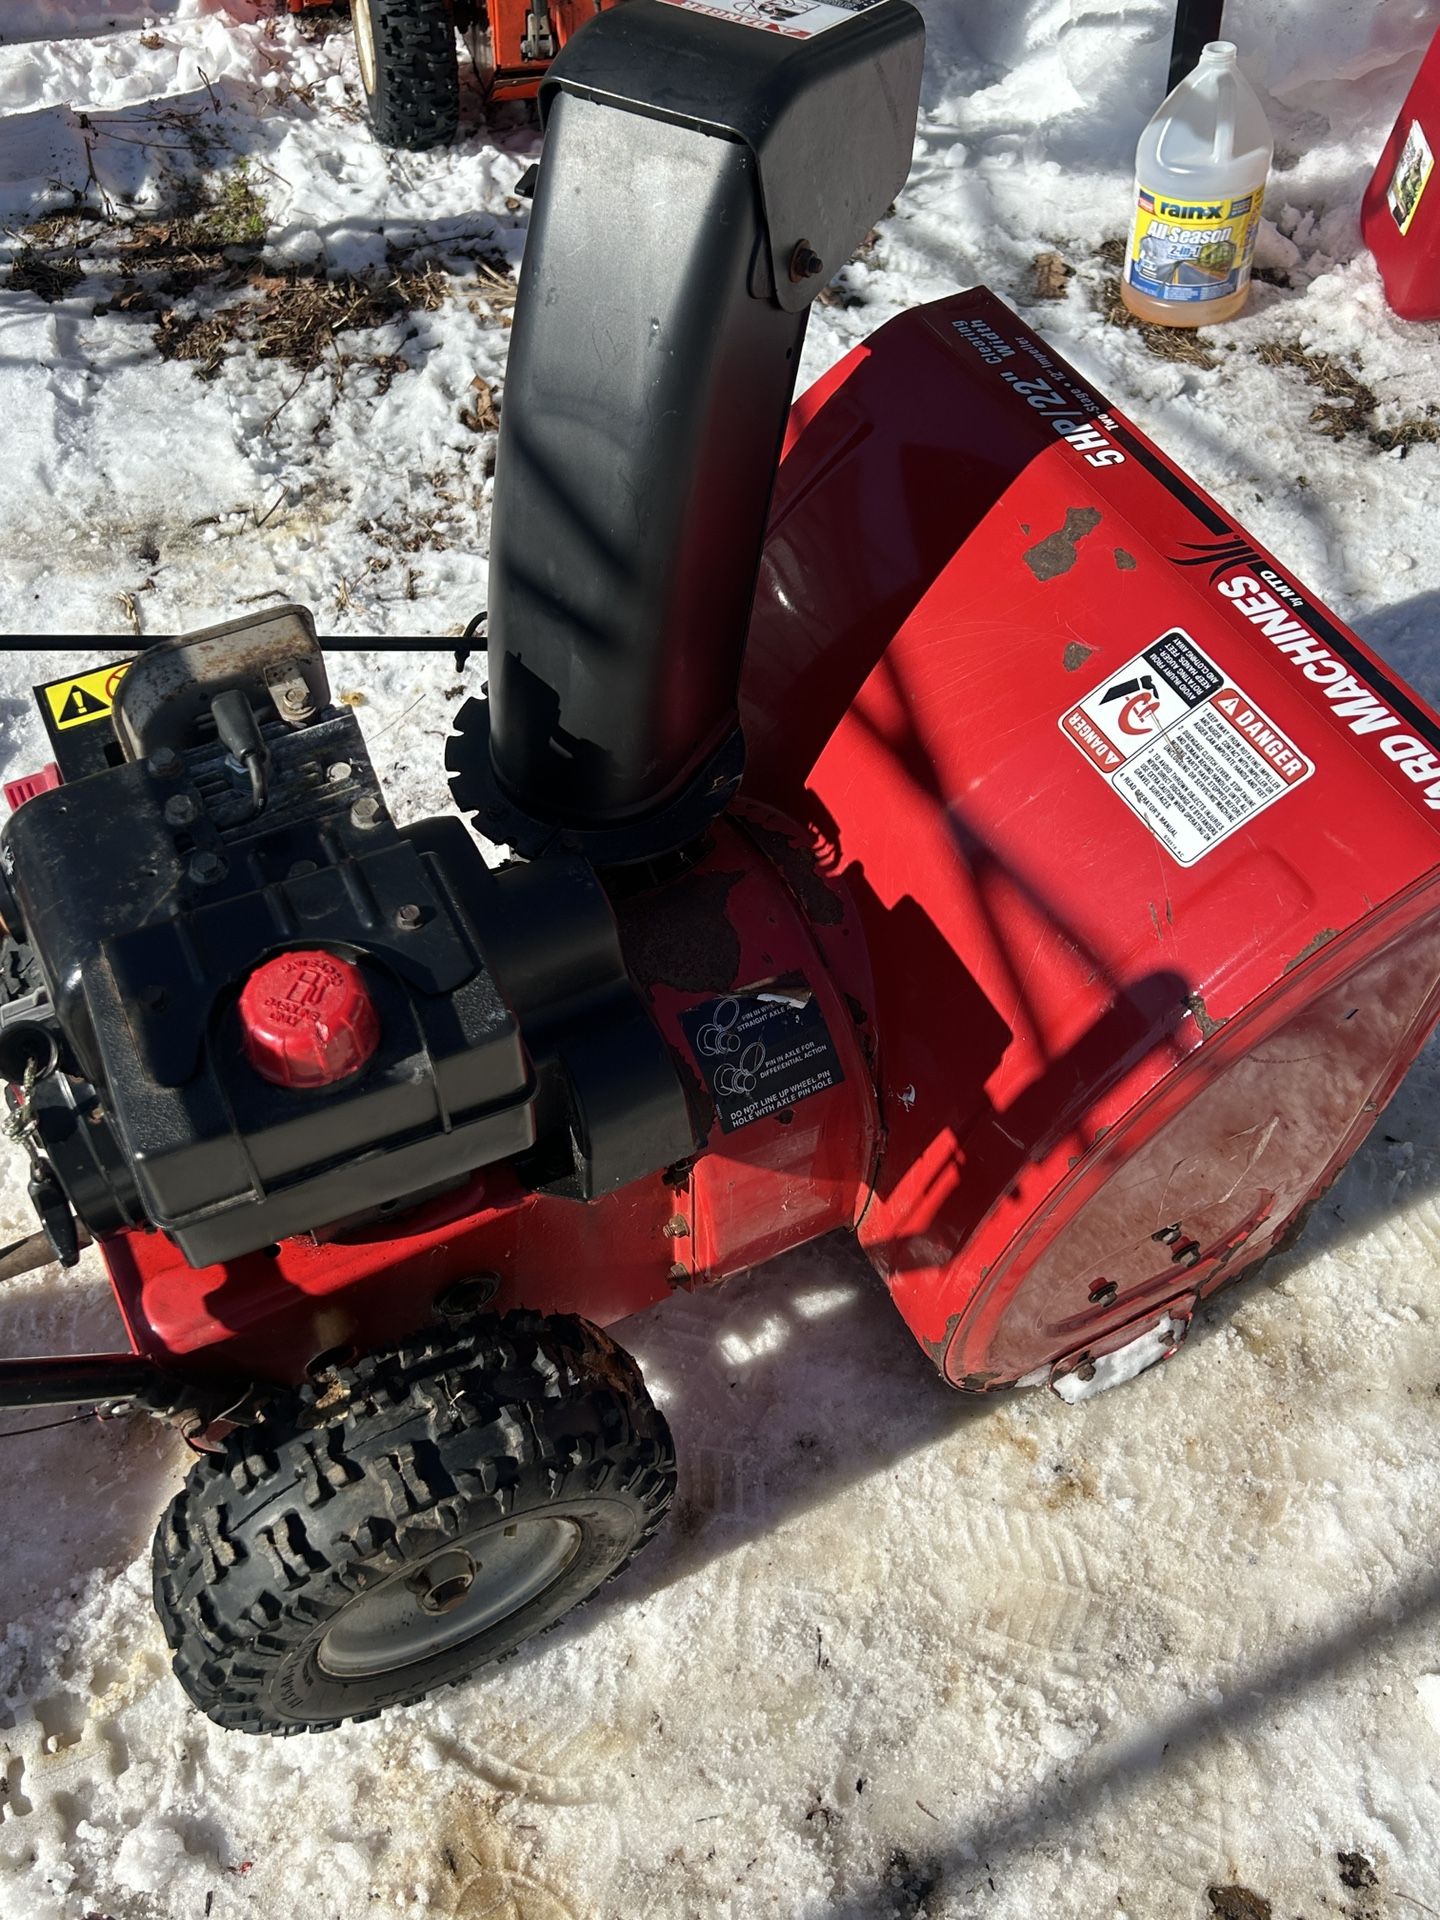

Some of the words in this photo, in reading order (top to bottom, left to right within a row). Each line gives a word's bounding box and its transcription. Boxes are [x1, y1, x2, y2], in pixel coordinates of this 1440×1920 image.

[680, 1, 771, 29] DANGER
[1169, 245, 1202, 257] 2-in-1
[952, 320, 1003, 365] Clearing
[970, 319, 1016, 358] Width
[1014, 336, 1054, 369] Impeller
[1070, 388, 1120, 431] Two-Stage
[1260, 569, 1296, 598] MTD
[1289, 594, 1304, 607] by
[1148, 652, 1166, 669] FROM
[1158, 649, 1180, 670] AUGER
[1163, 641, 1181, 658] FEET
[1184, 649, 1210, 675] CLOTHING
[1217, 575, 1401, 736] MACHINES
[1161, 666, 1182, 686] INJURY
[1174, 666, 1204, 696] ROTATING
[1177, 682, 1197, 702] AVOID
[1193, 672, 1212, 690] KEEP
[1205, 670, 1219, 685] AND
[1064, 710, 1110, 757] DANGER
[1235, 710, 1303, 777] DANGER
[1181, 729, 1204, 752] DISENGAGE
[1200, 749, 1218, 768] CLUTCH
[1228, 780, 1243, 794] STOP
[1191, 720, 1209, 737] AUGER
[1204, 733, 1217, 746] CAN
[1212, 742, 1236, 766] AMPUTATE
[1232, 763, 1250, 780] HANDS
[1245, 777, 1258, 790] AND
[1253, 786, 1268, 800] FEET
[1198, 715, 1210, 727] AND
[1220, 739, 1241, 759] CONTACT
[1236, 756, 1250, 770] WITH
[1245, 766, 1268, 789] IMPELLER
[1263, 785, 1274, 795] OR
[1204, 711, 1219, 725] KEEP
[1214, 721, 1230, 736] AWAY
[1226, 733, 1242, 749] FROM
[1237, 745, 1261, 769] ROTATING
[1257, 766, 1281, 790] IMPELLER
[1122, 775, 1138, 791] READ
[1132, 766, 1152, 787] GRAVEL
[1145, 756, 1161, 772] NEVER
[1156, 768, 1173, 786] DIRECT
[1167, 782, 1191, 806] DISCHARGE
[1186, 803, 1196, 812] AT
[1151, 752, 1162, 761] TO
[1157, 758, 1173, 774] AVOID
[1169, 771, 1190, 793] THROWN
[1185, 789, 1207, 812] OBJECTS
[1162, 743, 1191, 773] UNCLOGGING
[1186, 770, 1197, 780] OR
[1192, 777, 1218, 803] SERVICING
[1174, 733, 1187, 746] AND
[1182, 742, 1201, 761] REMAIN
[1196, 757, 1214, 775] BEHIND
[1210, 772, 1231, 794] HANDLES
[1226, 790, 1242, 805] UNTIL
[1238, 802, 1250, 813] ALL
[1183, 755, 1200, 772] PARTS
[1195, 768, 1210, 783] HAVE
[1205, 779, 1228, 802] STOPPED
[1223, 798, 1243, 818] BEFORE
[1139, 761, 1150, 773] USE
[1146, 769, 1161, 785] EXTRA
[1156, 782, 1176, 802] CAUTION
[1171, 798, 1187, 814] WHEN
[1182, 810, 1206, 836] OPERATING
[1201, 832, 1212, 842] ON
[735, 1013, 769, 1031] STRAIGHT
[767, 1006, 786, 1018] AXLE
[741, 1011, 753, 1021] PIN
[751, 1007, 761, 1016] IN
[758, 1056, 805, 1077] DIFFERENTIAL
[802, 1044, 828, 1058] ACTION
[763, 1057, 777, 1068] PIN
[775, 1054, 784, 1062] IN
[782, 1047, 801, 1059] AXLE
[799, 1040, 815, 1051] FOR
[729, 1109, 742, 1120] DO
[742, 1101, 759, 1114] NOT
[759, 1092, 778, 1107] LINE
[777, 1087, 790, 1098] UP
[788, 1075, 816, 1093] WHEEL
[816, 1069, 831, 1081] PIN
[731, 1112, 754, 1128] HOLE
[753, 1103, 775, 1118] WITH
[775, 1093, 796, 1108] AXLE
[796, 1086, 811, 1098] PIN
[810, 1076, 833, 1092] HOLE
